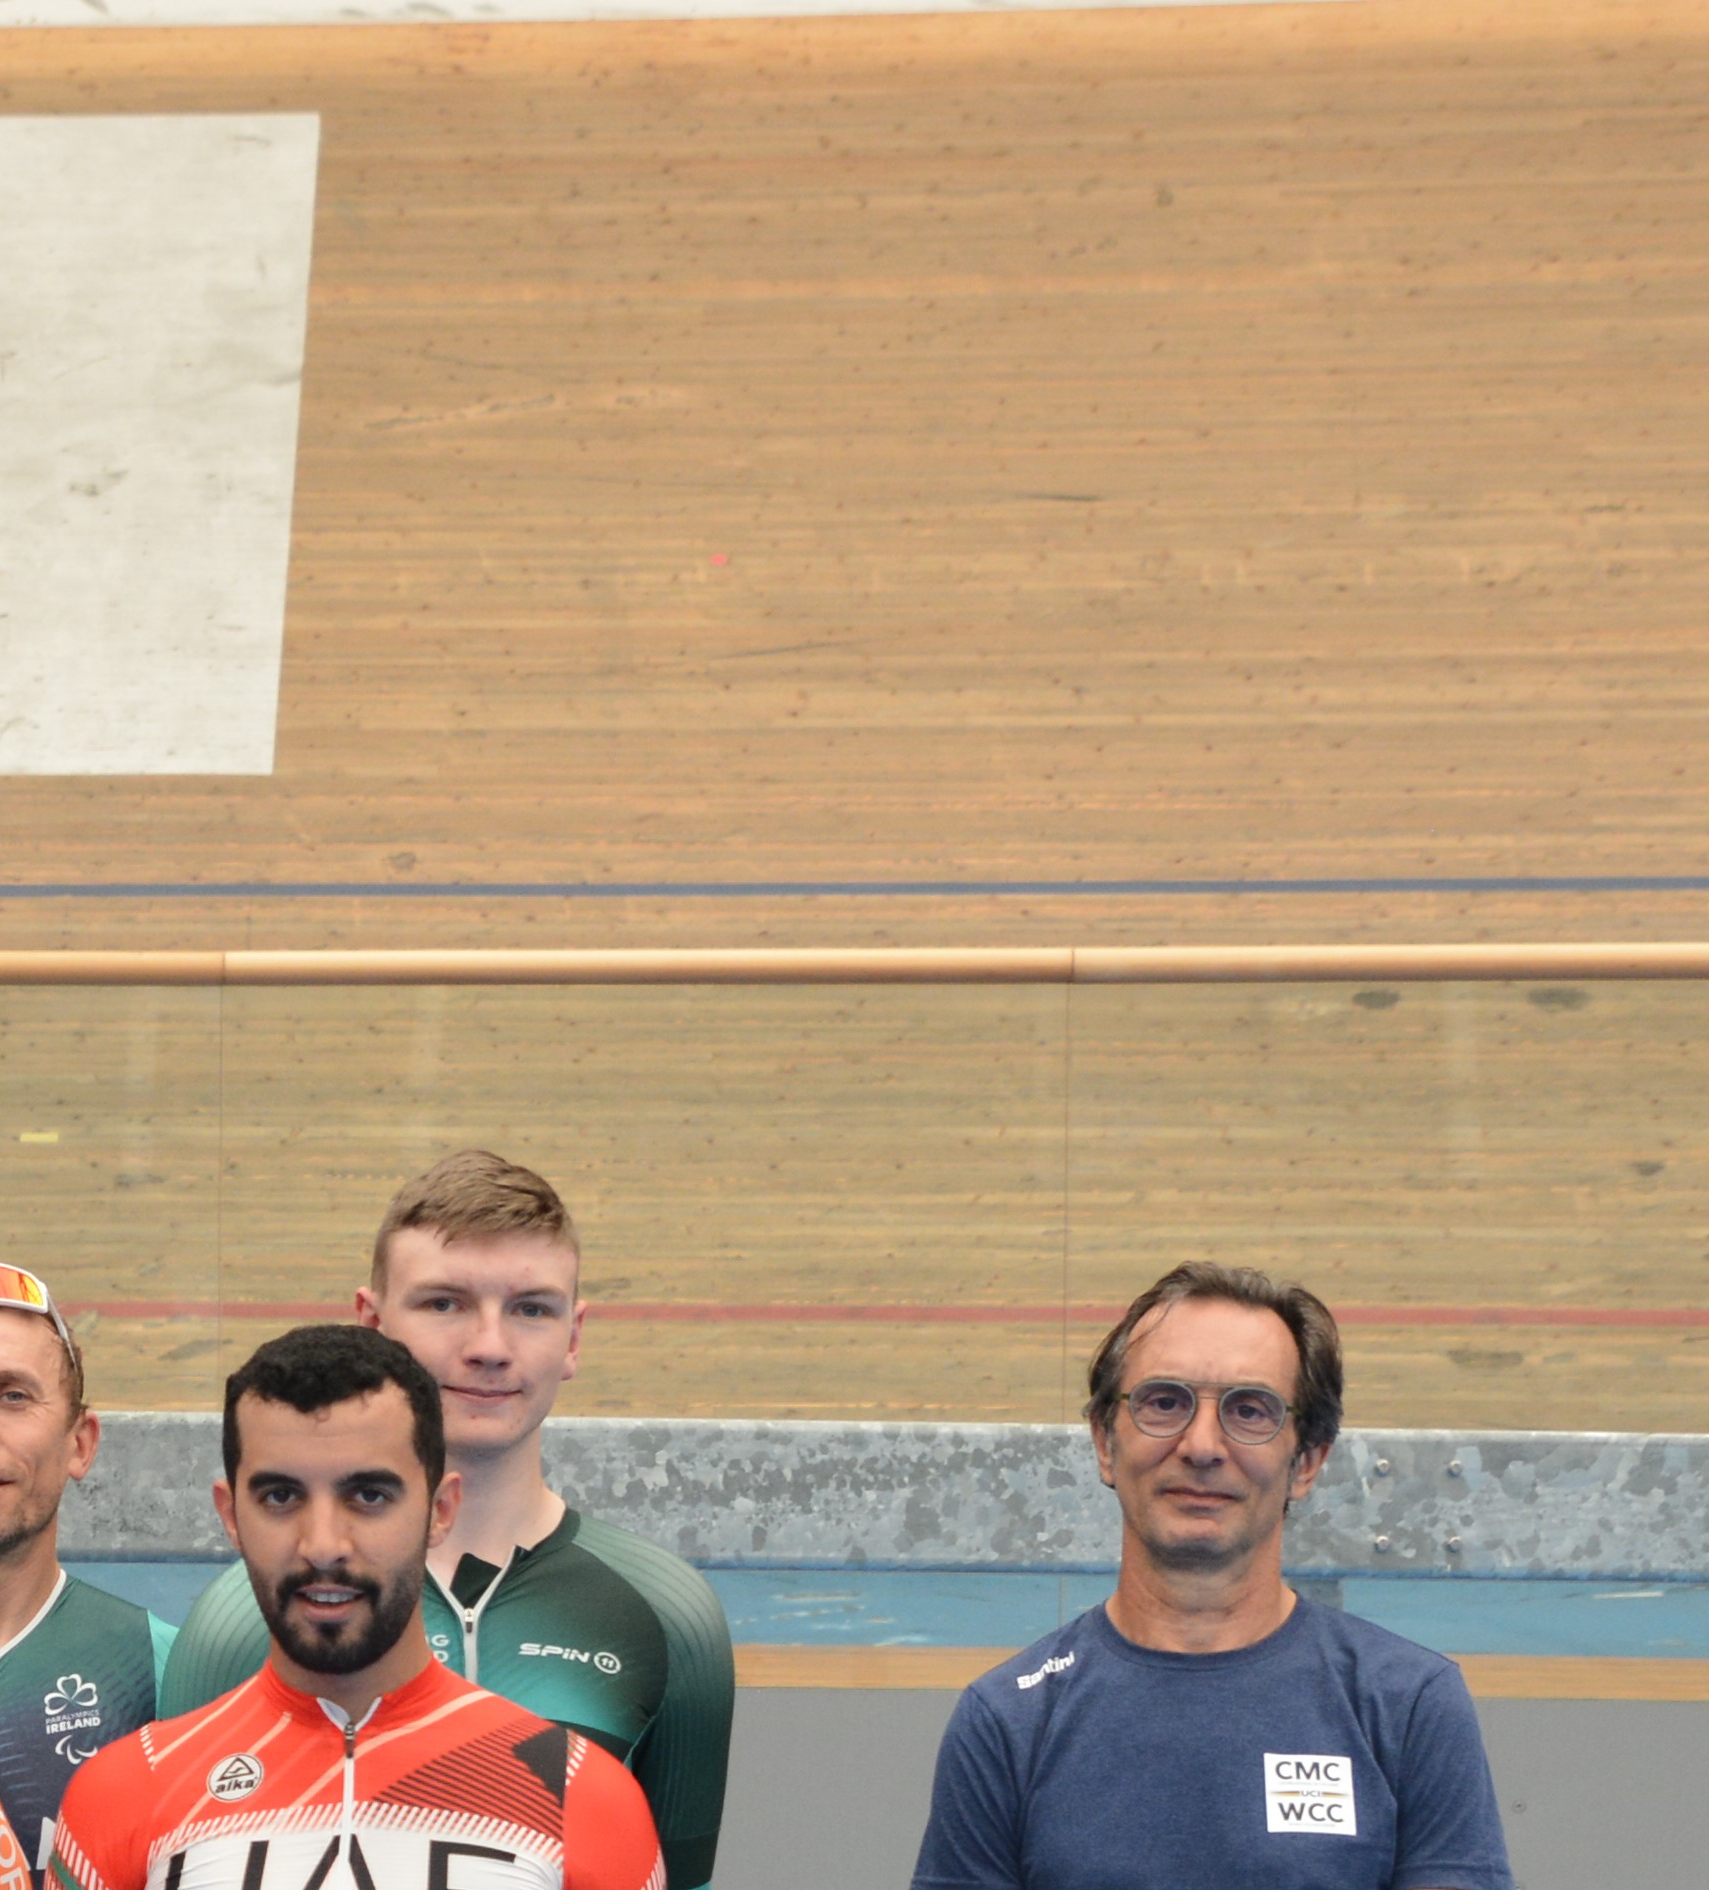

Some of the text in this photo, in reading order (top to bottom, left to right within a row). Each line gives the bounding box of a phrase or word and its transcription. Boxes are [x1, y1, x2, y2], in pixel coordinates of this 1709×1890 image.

[45, 1716, 102, 1735] IRELAND
[1275, 1761, 1341, 1782] CMC
[1278, 1803, 1345, 1823] WCC
